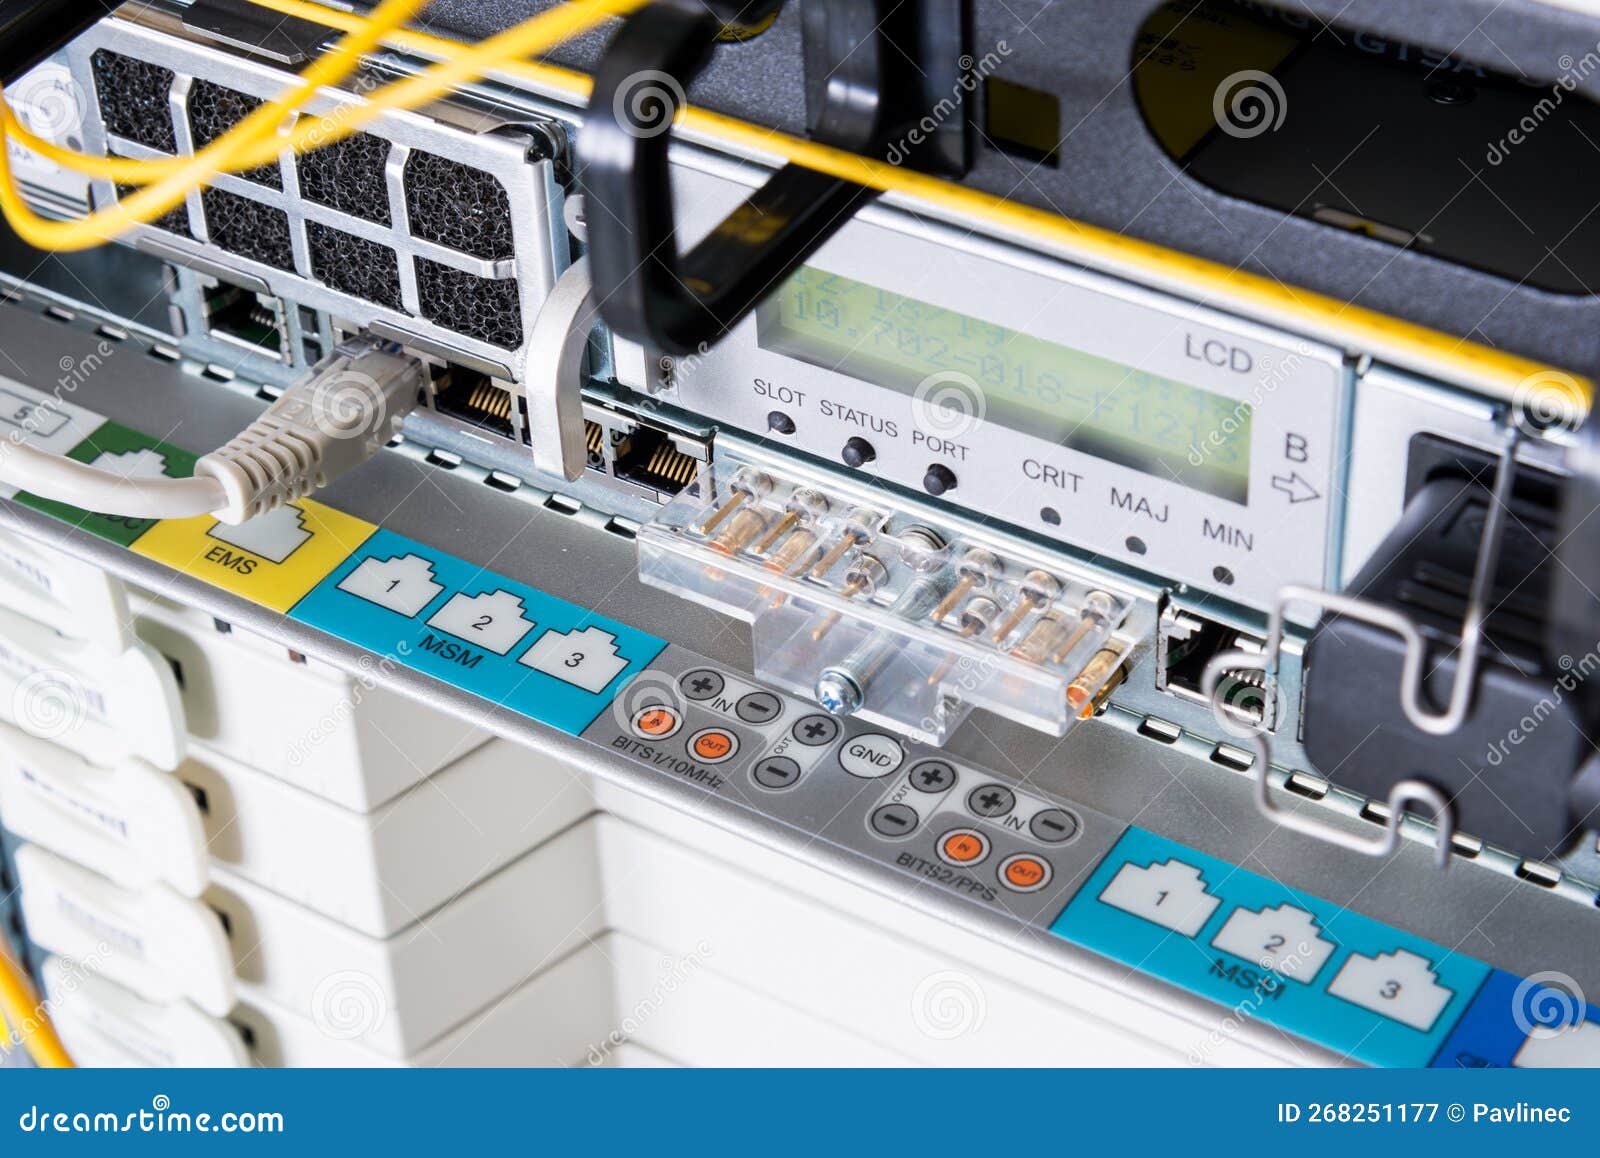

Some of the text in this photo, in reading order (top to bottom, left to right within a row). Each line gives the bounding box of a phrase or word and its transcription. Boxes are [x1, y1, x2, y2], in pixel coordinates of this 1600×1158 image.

[1185, 333, 1253, 374] LCD
[753, 378, 970, 461] SLOT STATUS PORT
[1285, 432, 1308, 463] B
[1022, 458, 1254, 552] CRIT MAJ MIN
[203, 546, 259, 575] EMS
[385, 579, 586, 668] 1 2 3
[417, 634, 485, 669] MSM
[711, 697, 733, 713] IN
[700, 738, 726, 752] OUT
[774, 737, 793, 755] OUT
[850, 744, 892, 767] GND
[611, 735, 725, 789] BITS1/10MHz
[1003, 814, 1026, 831] IN
[896, 852, 998, 901] BITS2/PPS
[1012, 865, 1039, 880] OUT
[1155, 890, 1402, 1000] 1 2 3
